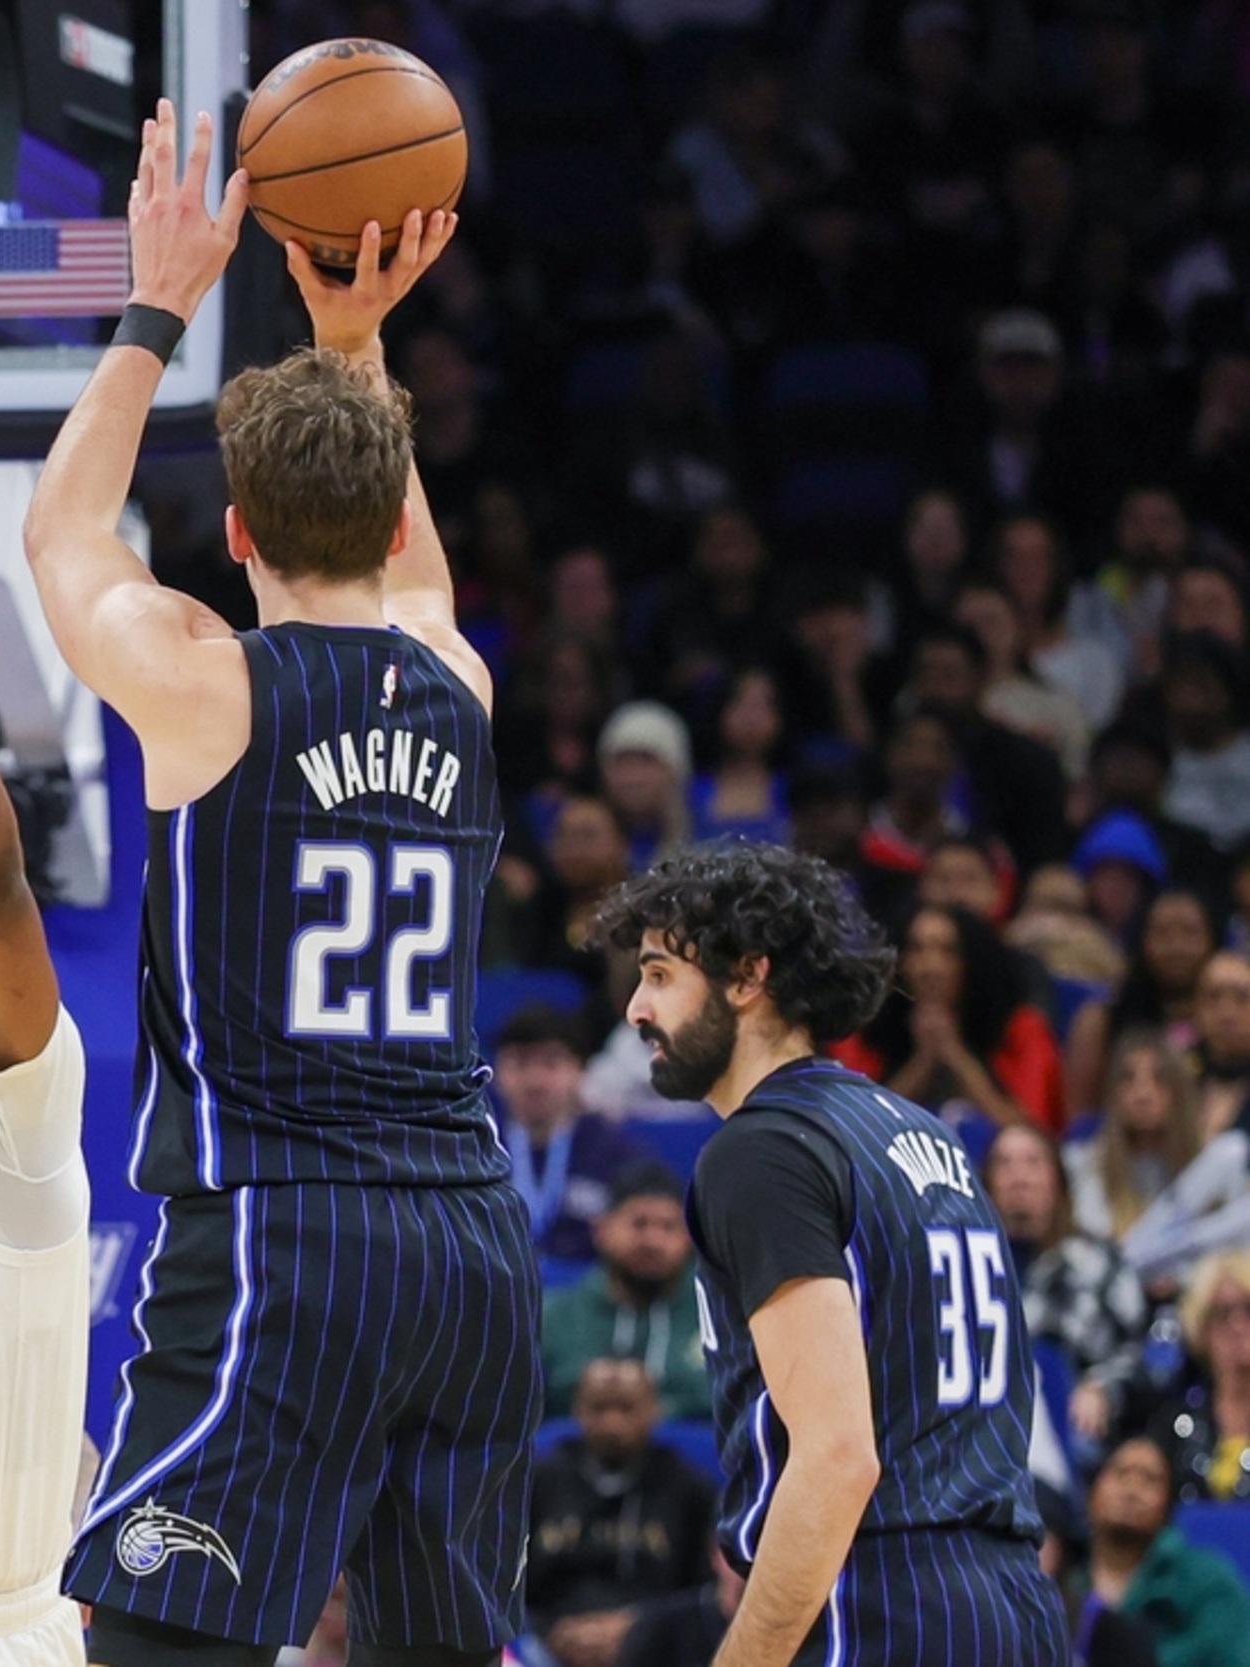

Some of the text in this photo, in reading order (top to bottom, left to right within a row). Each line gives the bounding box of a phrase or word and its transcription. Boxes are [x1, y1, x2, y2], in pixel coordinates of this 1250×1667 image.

[296, 728, 461, 818] WAGNER
[285, 839, 455, 1042] 22
[925, 1227, 1008, 1409] 35
